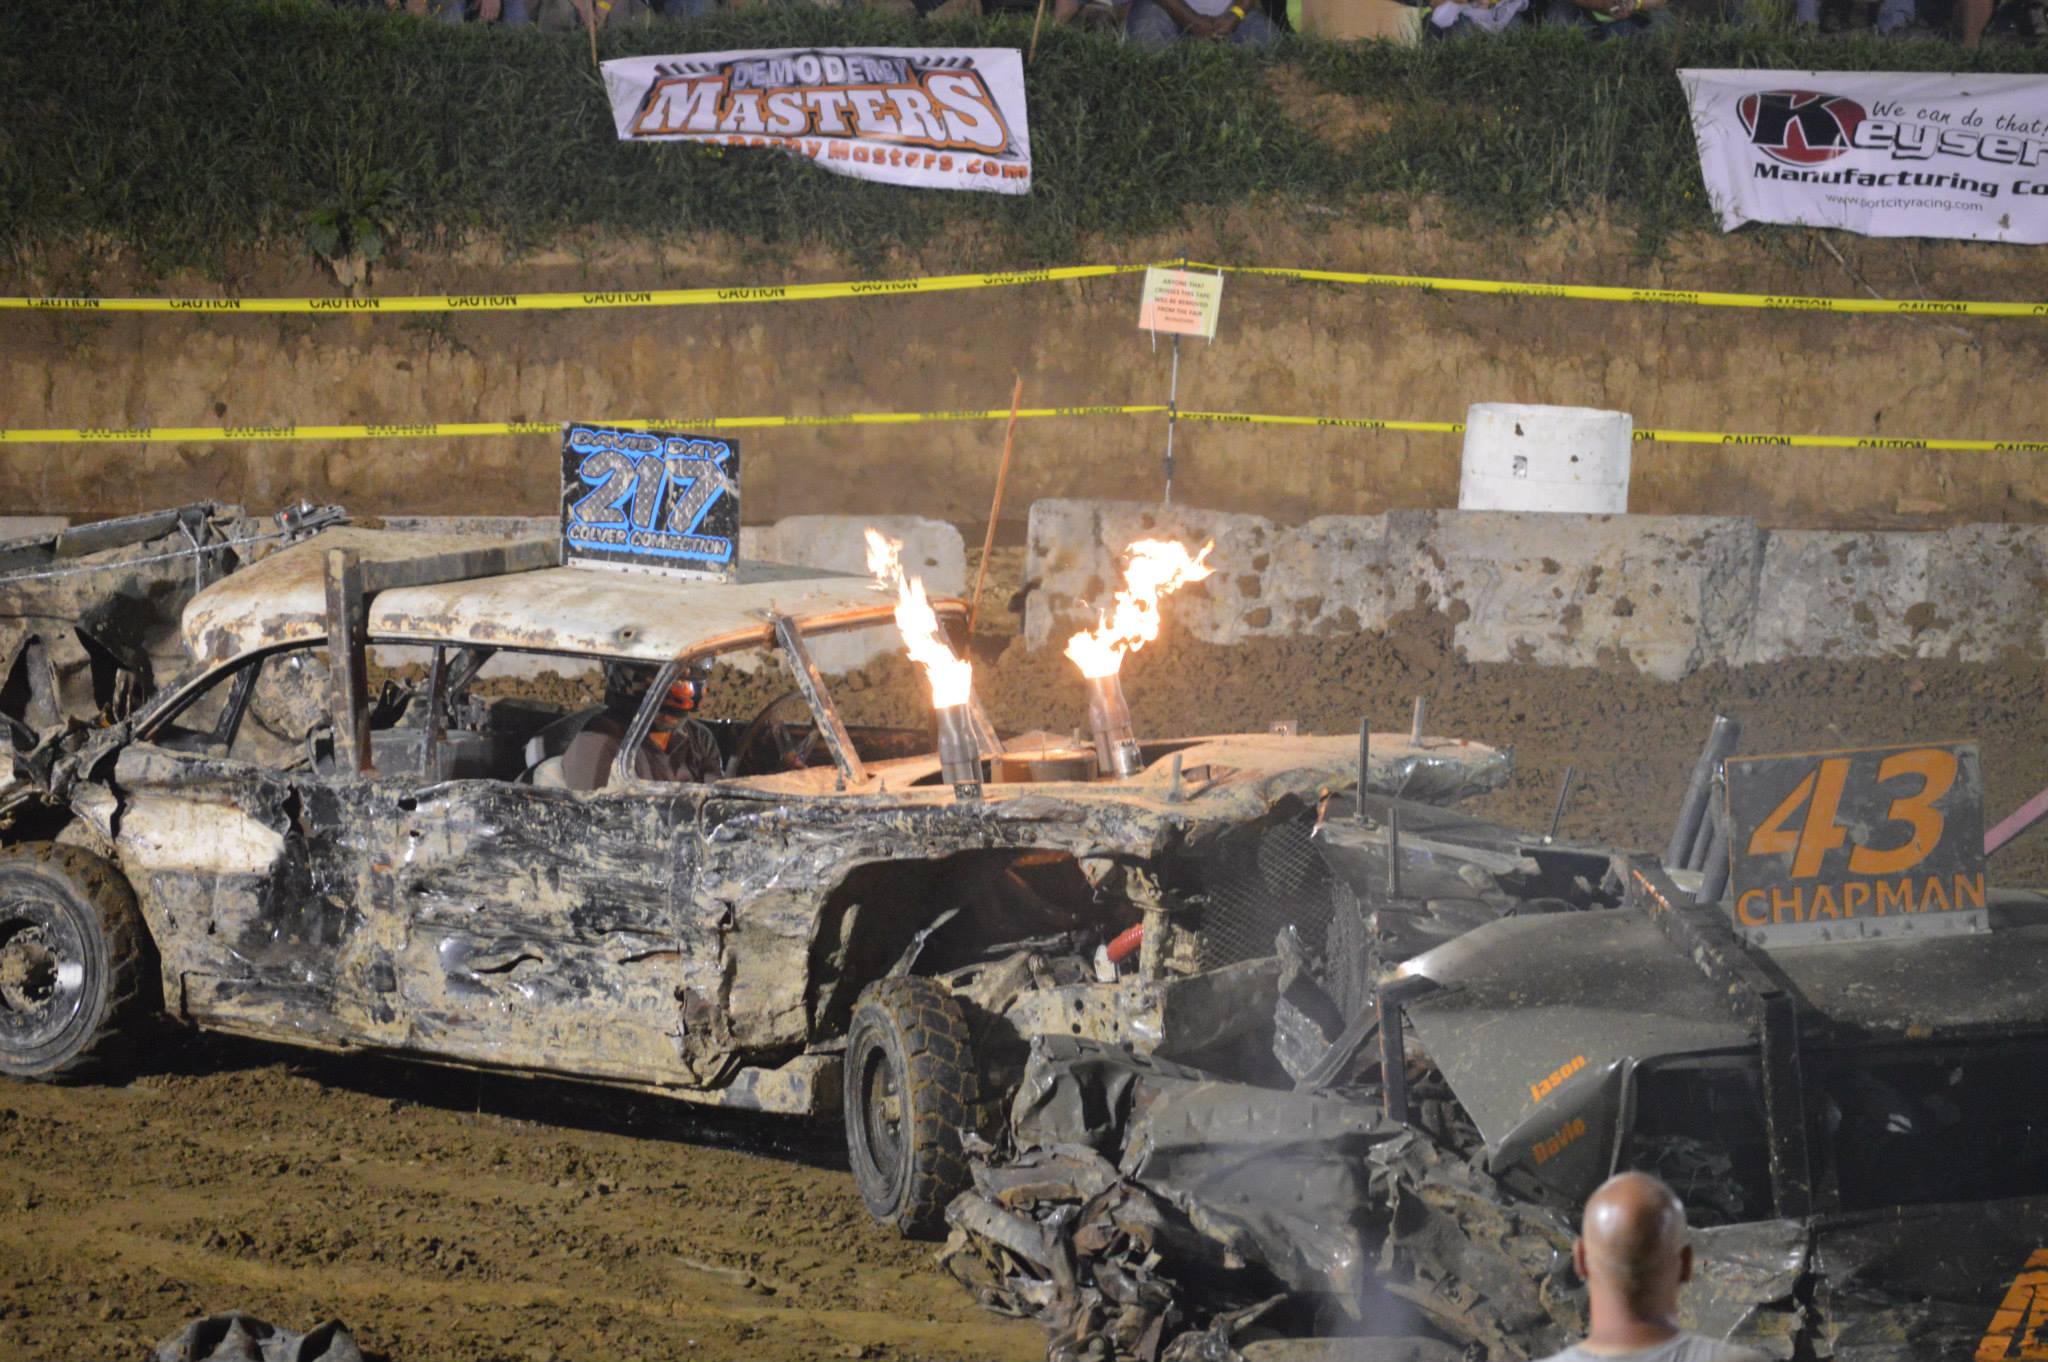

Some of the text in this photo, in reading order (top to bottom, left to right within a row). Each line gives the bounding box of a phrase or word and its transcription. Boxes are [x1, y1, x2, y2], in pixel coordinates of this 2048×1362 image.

[634, 72, 1006, 153] MASTERS
[1872, 101, 1905, 117] We
[1916, 109, 1951, 125] can
[1961, 108, 1984, 127] do
[1753, 162, 1999, 199] Manufacturing
[572, 450, 725, 534] 217
[569, 524, 728, 555] COLVER CONNECTION
[1747, 748, 1958, 879] 43
[1735, 872, 1986, 927] CHAPMAN
